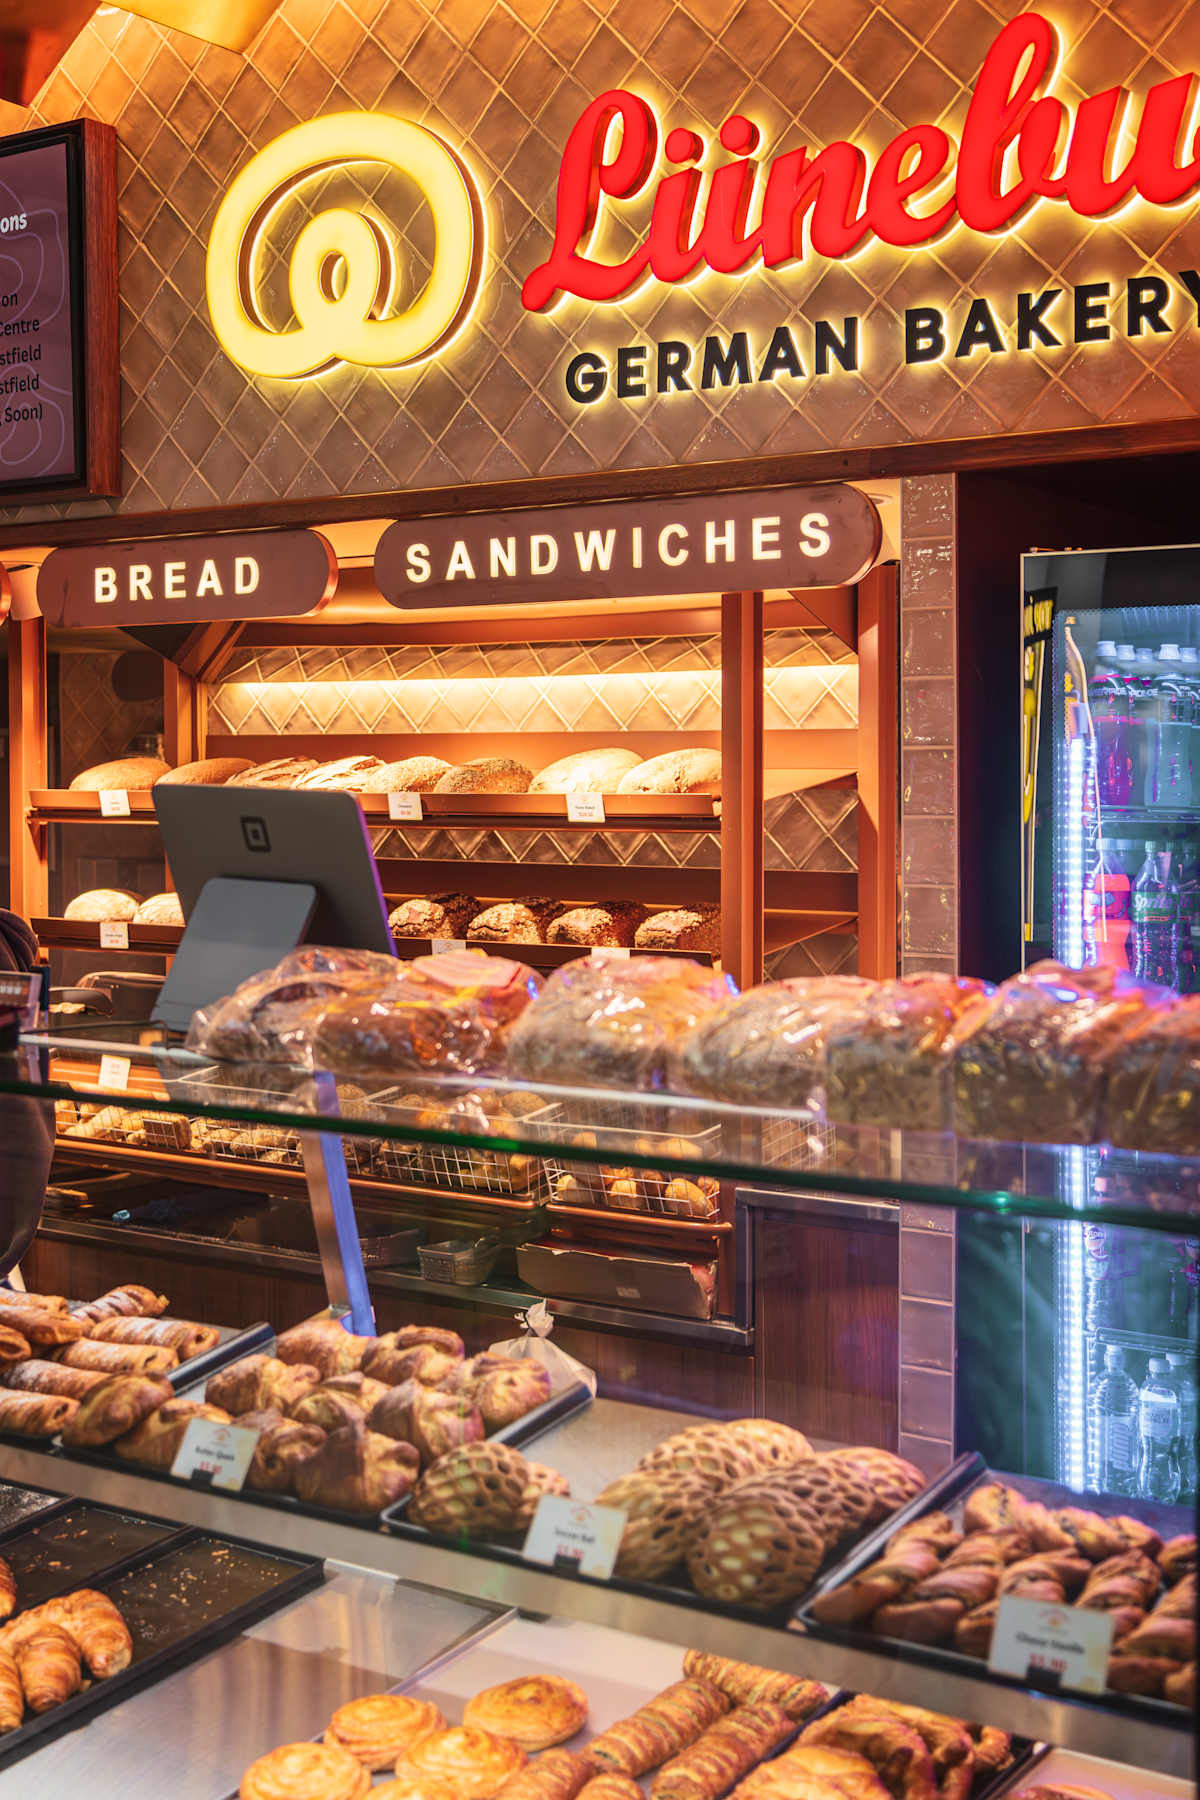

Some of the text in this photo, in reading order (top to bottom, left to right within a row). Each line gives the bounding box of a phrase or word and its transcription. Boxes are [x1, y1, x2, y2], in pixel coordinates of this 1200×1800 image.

[0, 214, 27, 233] ons
[565, 316, 859, 404] GERMAN
[4, 402, 42, 423] Soon)
[405, 512, 831, 584] SANDWICHES
[94, 556, 260, 604] BREAD
